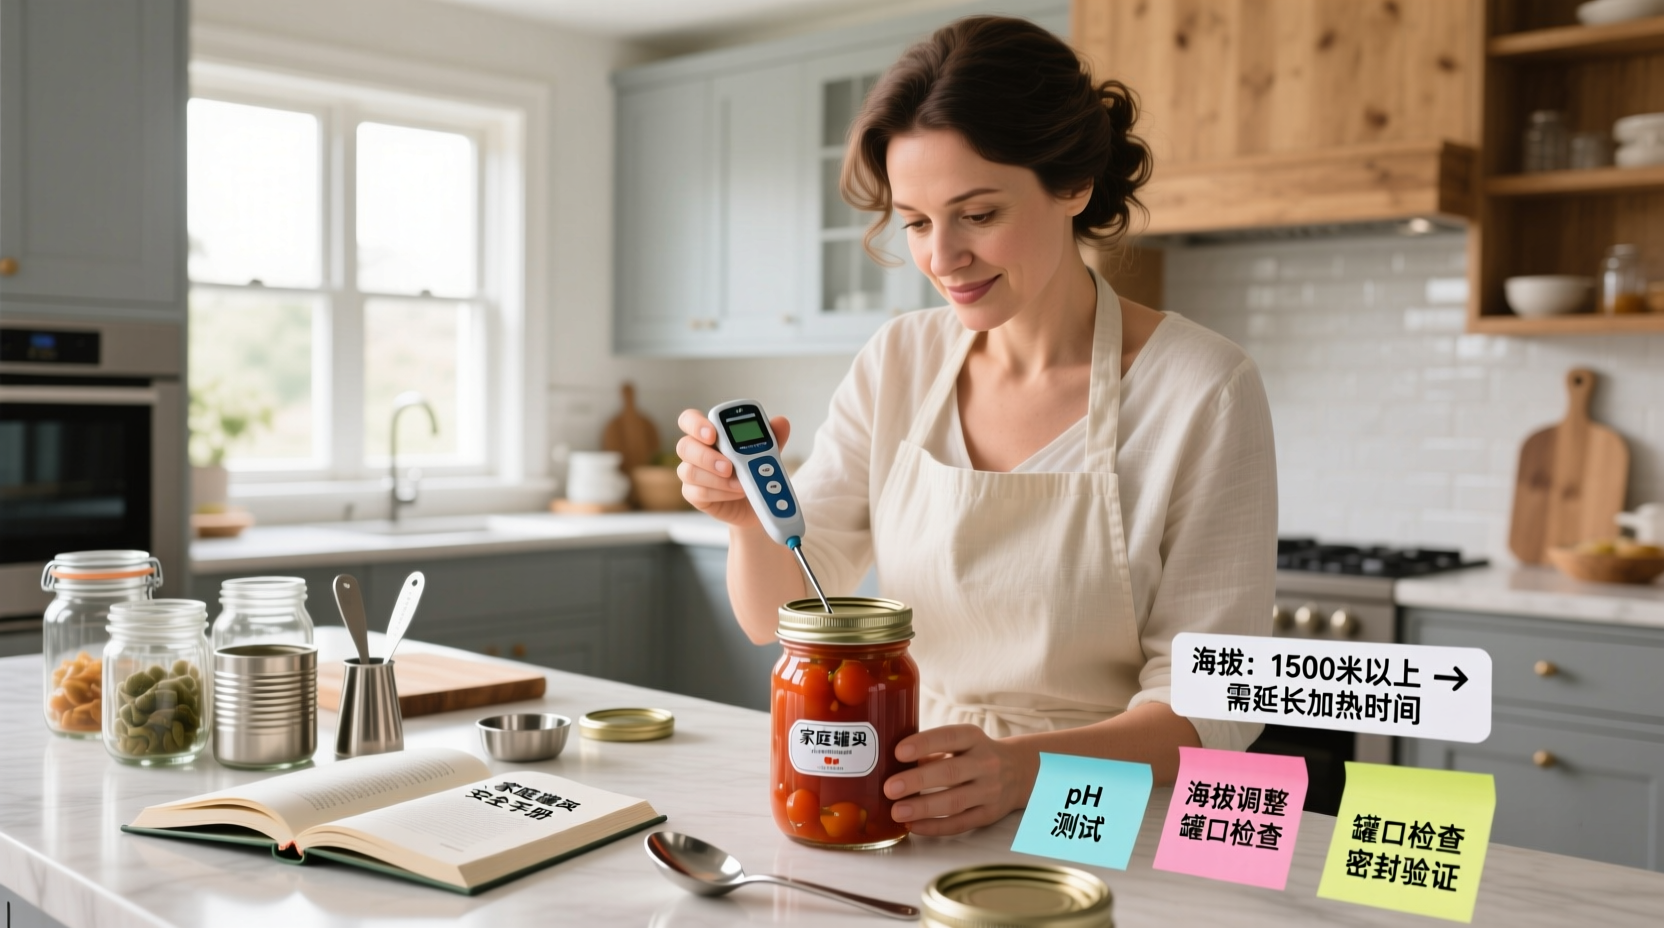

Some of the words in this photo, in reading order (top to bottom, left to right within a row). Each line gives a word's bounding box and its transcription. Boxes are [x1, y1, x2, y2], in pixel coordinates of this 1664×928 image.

[1065, 784, 1104, 809] pH
[1185, 780, 1290, 817] 海拔调整
[1050, 811, 1105, 842] 测试
[1179, 812, 1284, 851] 罐口检查
[1351, 813, 1466, 855] 罐口检查
[1345, 848, 1461, 892] 密封验证
